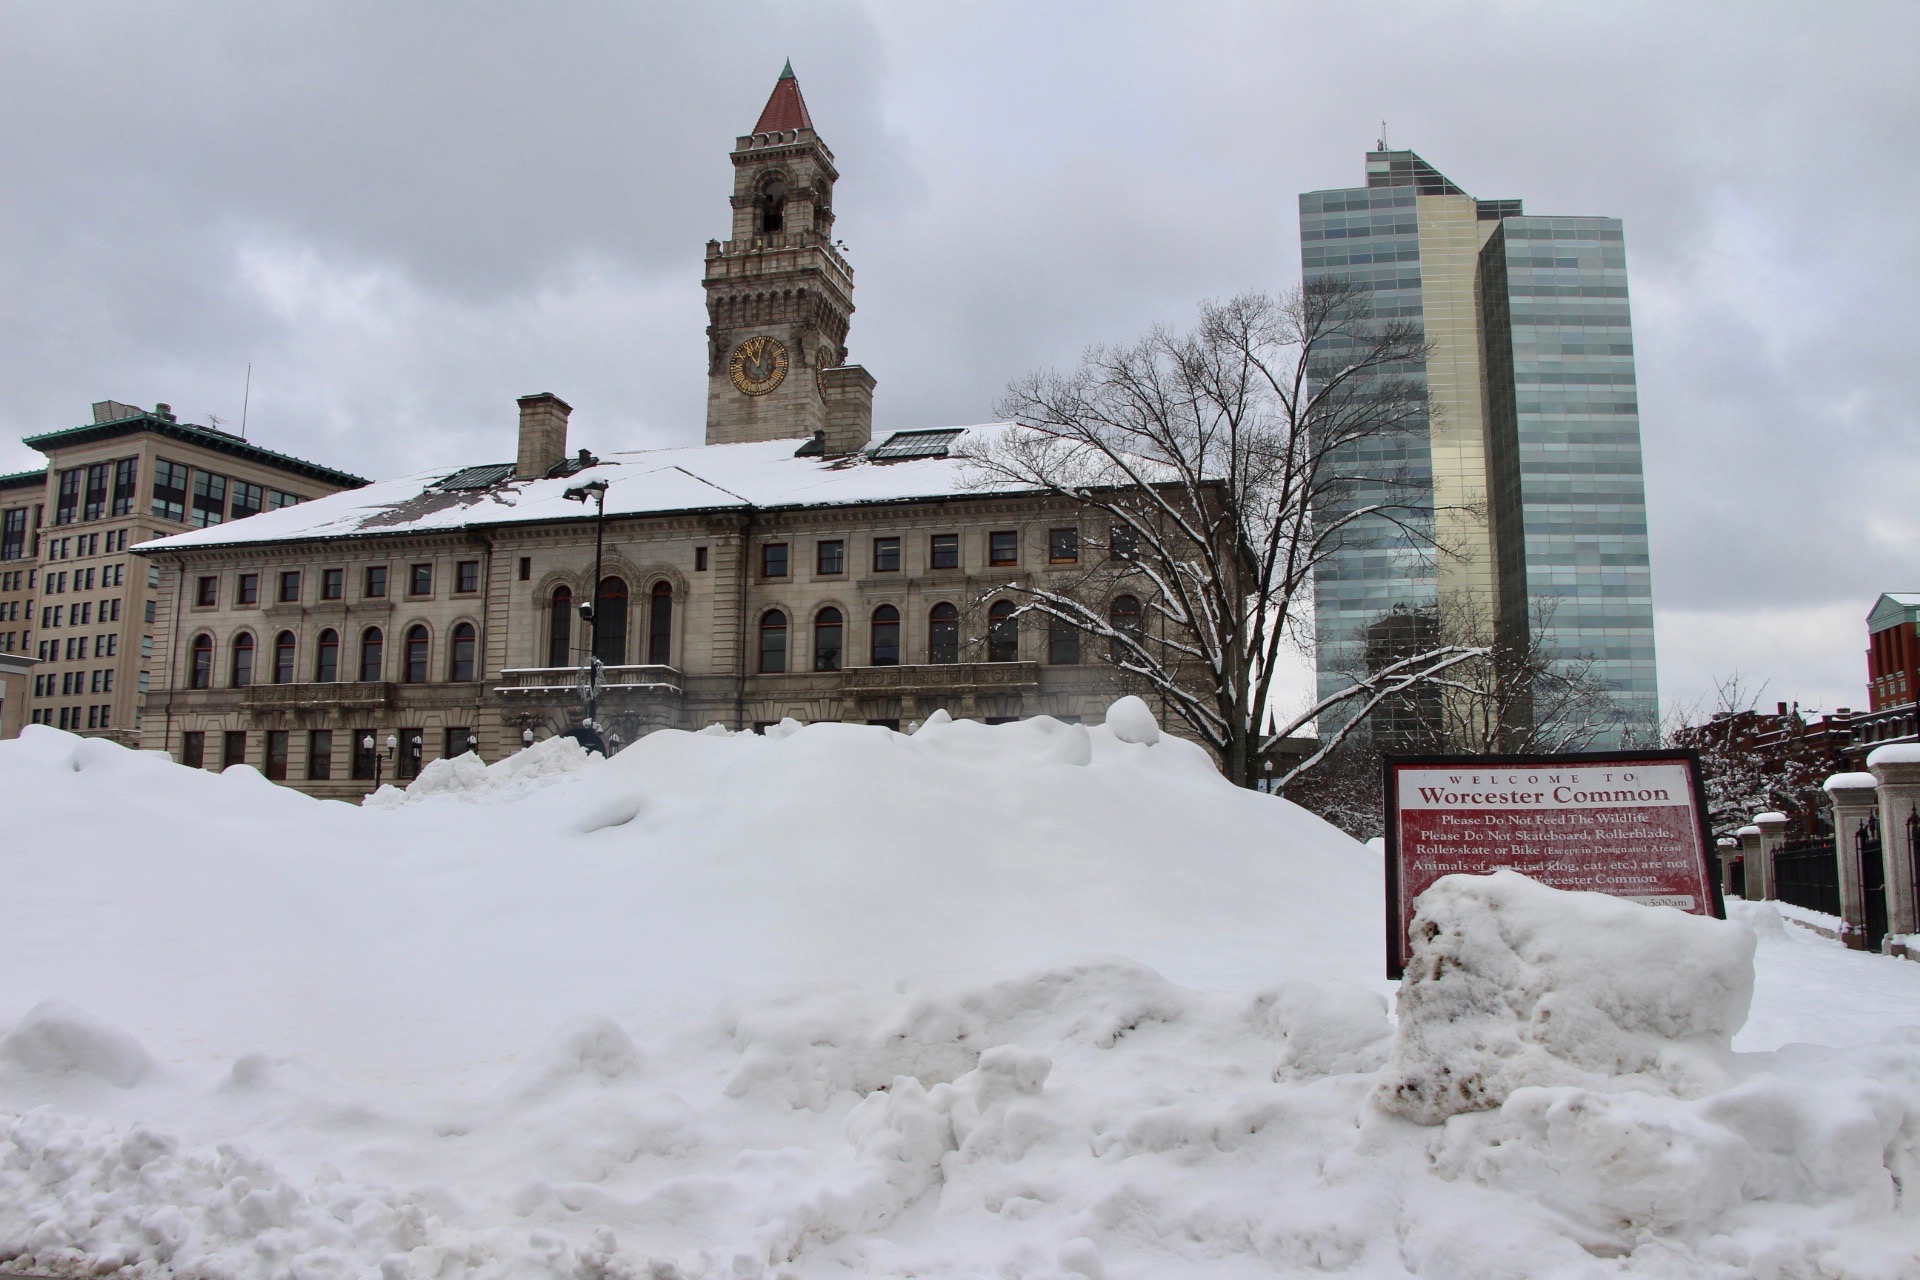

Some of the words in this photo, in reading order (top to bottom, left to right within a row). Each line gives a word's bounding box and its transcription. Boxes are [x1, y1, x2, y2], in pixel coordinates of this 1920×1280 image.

[1449, 775, 1579, 785] WELCOME
[1603, 772, 1635, 783] TO
[1417, 786, 1545, 805] Worcester
[1552, 785, 1670, 804] Common
[1441, 815, 1481, 825] Please
[1484, 814, 1505, 825] Do
[1508, 815, 1532, 825] Not
[1535, 814, 1566, 825] Feed
[1567, 814, 1594, 824] The
[1595, 812, 1650, 824] Wildlife
[1421, 830, 1460, 841] Please
[1464, 830, 1484, 841] Do
[1487, 830, 1512, 841] Not
[1515, 829, 1592, 841] Skateboard,
[1594, 827, 1675, 840] Rollerblade,
[1416, 844, 1491, 855] Roller-skate
[1494, 847, 1508, 855] or
[1511, 844, 1541, 855] Bike
[1544, 846, 1579, 856] (Except
[1581, 846, 1591, 854] in
[1594, 844, 1648, 855] Designated
[1650, 843, 1682, 853] Areas)
[1412, 860, 1470, 871] Animals
[1472, 860, 1486, 871] of
[1513, 860, 1544, 871] kind
[1583, 861, 1607, 871] cat,
[1610, 860, 1638, 871] etc.)
[1641, 860, 1663, 870] are
[1666, 859, 1689, 869] not
[1595, 873, 1658, 884] Common
[1650, 898, 1688, 907] 5:00am
